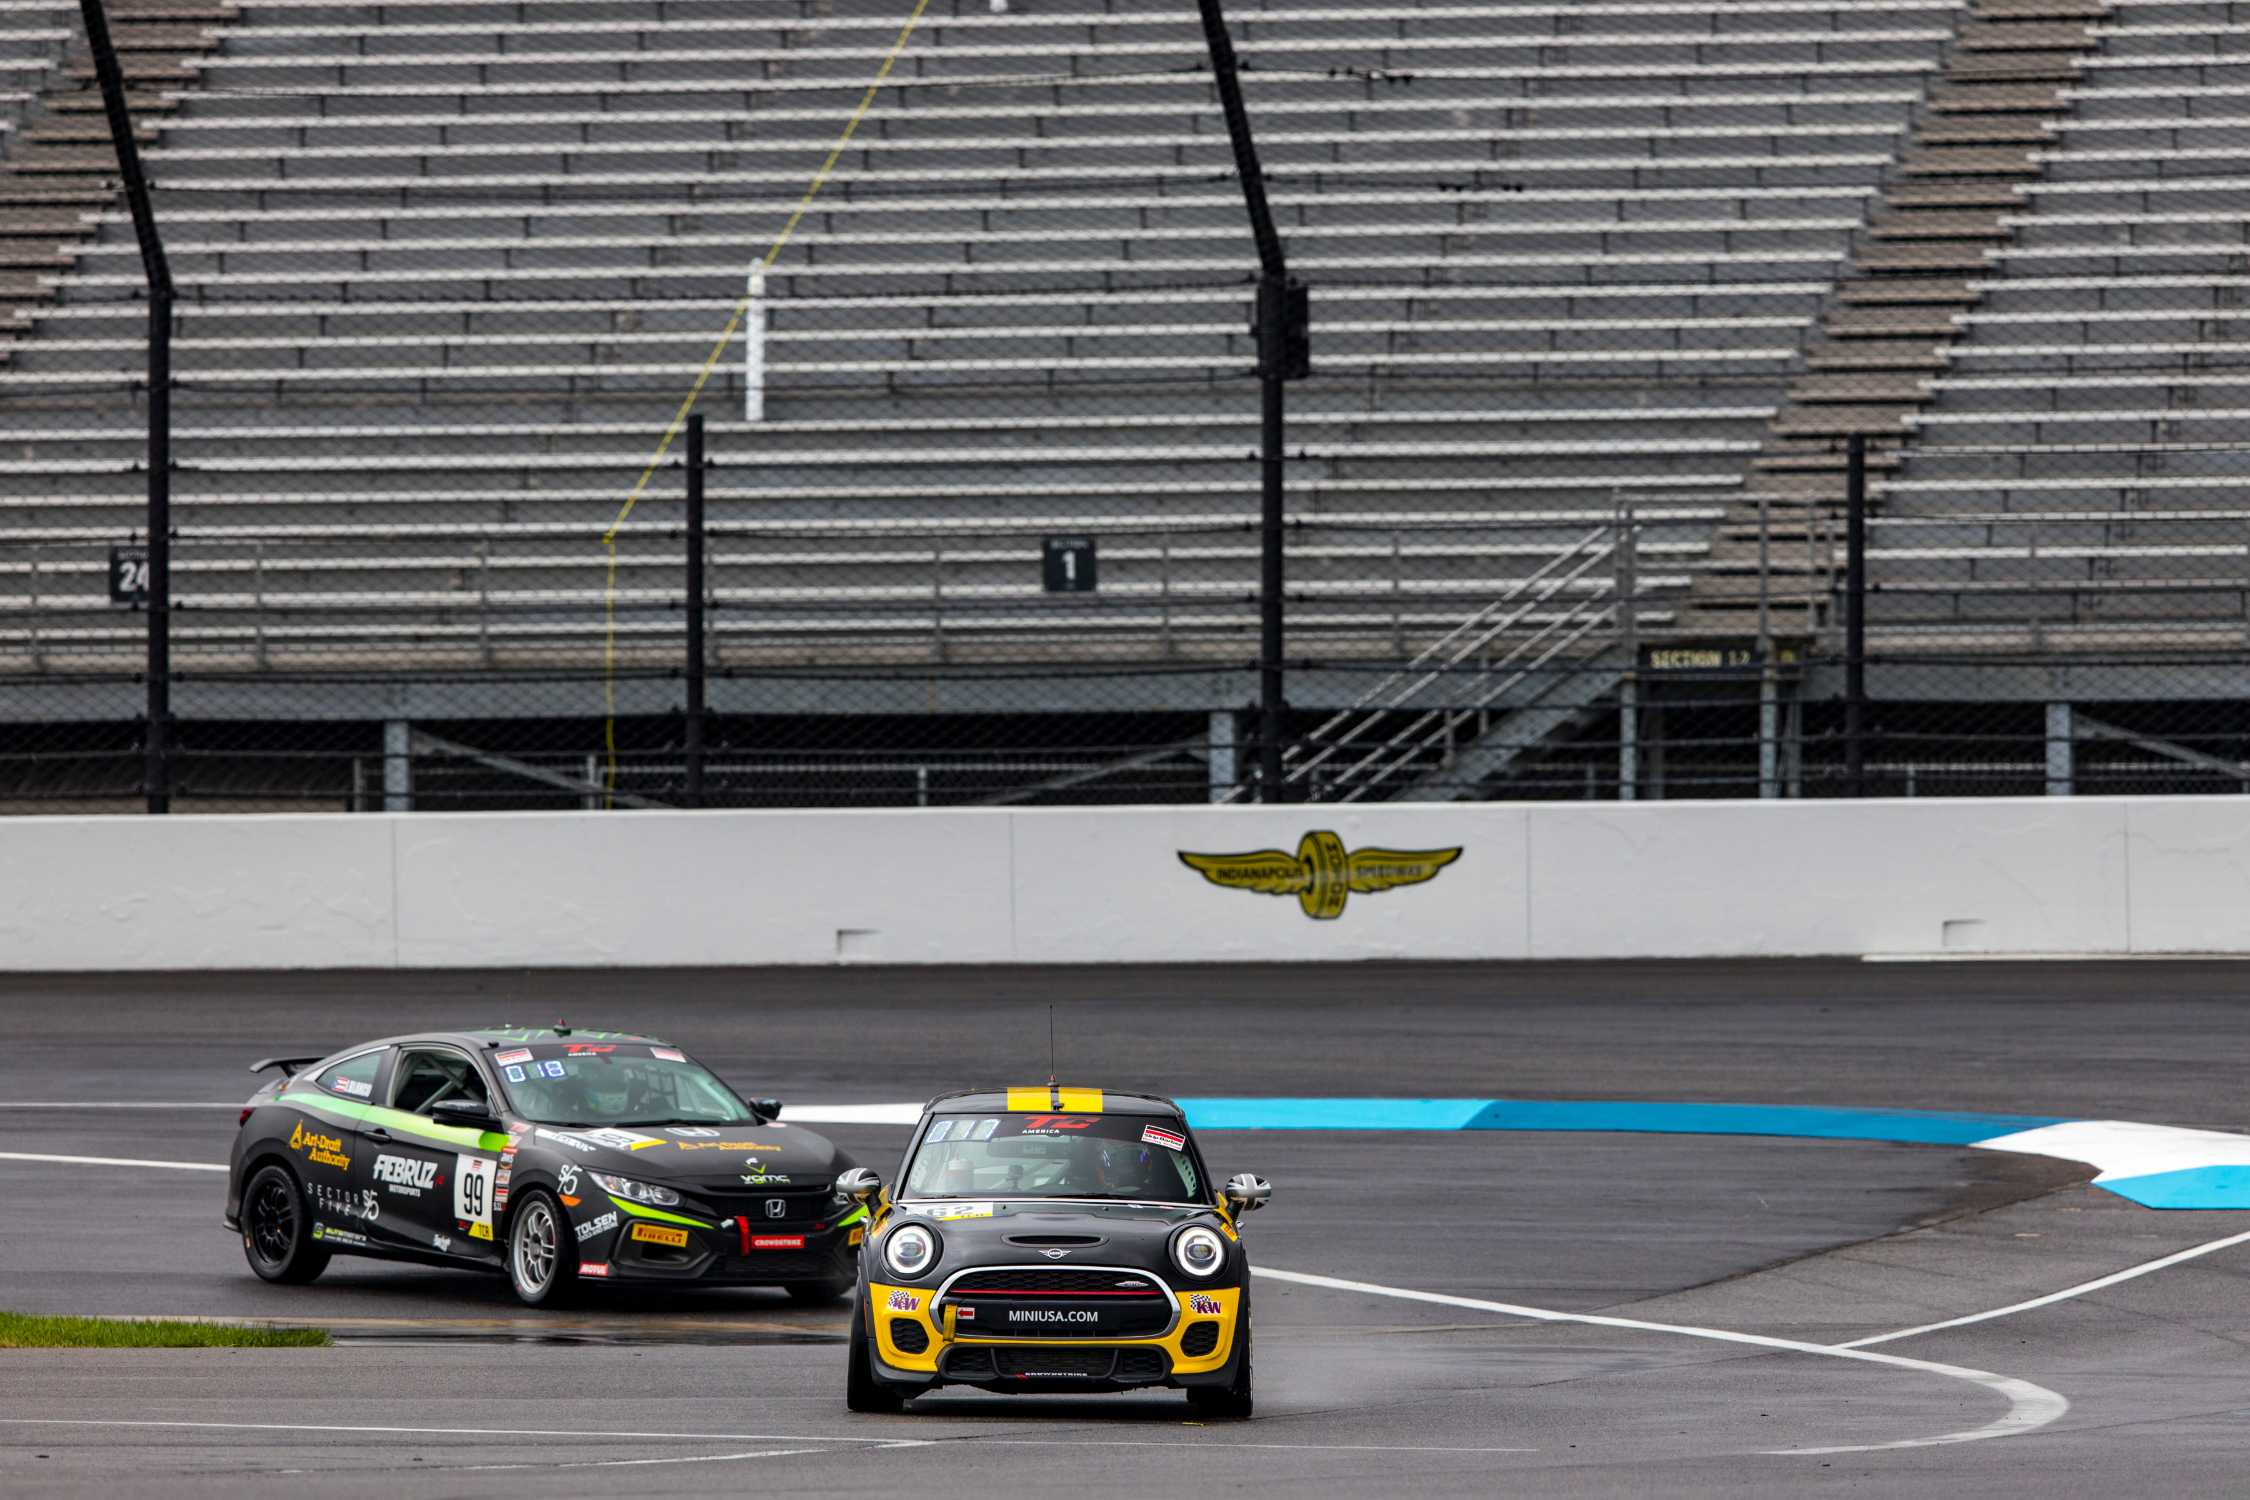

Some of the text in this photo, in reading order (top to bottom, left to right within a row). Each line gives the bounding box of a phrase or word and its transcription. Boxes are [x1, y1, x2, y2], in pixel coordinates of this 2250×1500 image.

[1062, 550, 1076, 580] 1
[1024, 1115, 1101, 1129] TC
[463, 1172, 484, 1217] 99
[574, 1210, 618, 1238] TOLSEN
[637, 1227, 683, 1244] PIRELLI
[893, 1297, 921, 1312] KW
[1196, 1301, 1222, 1315] KW
[1008, 1310, 1099, 1323] MINIUSA.COM
